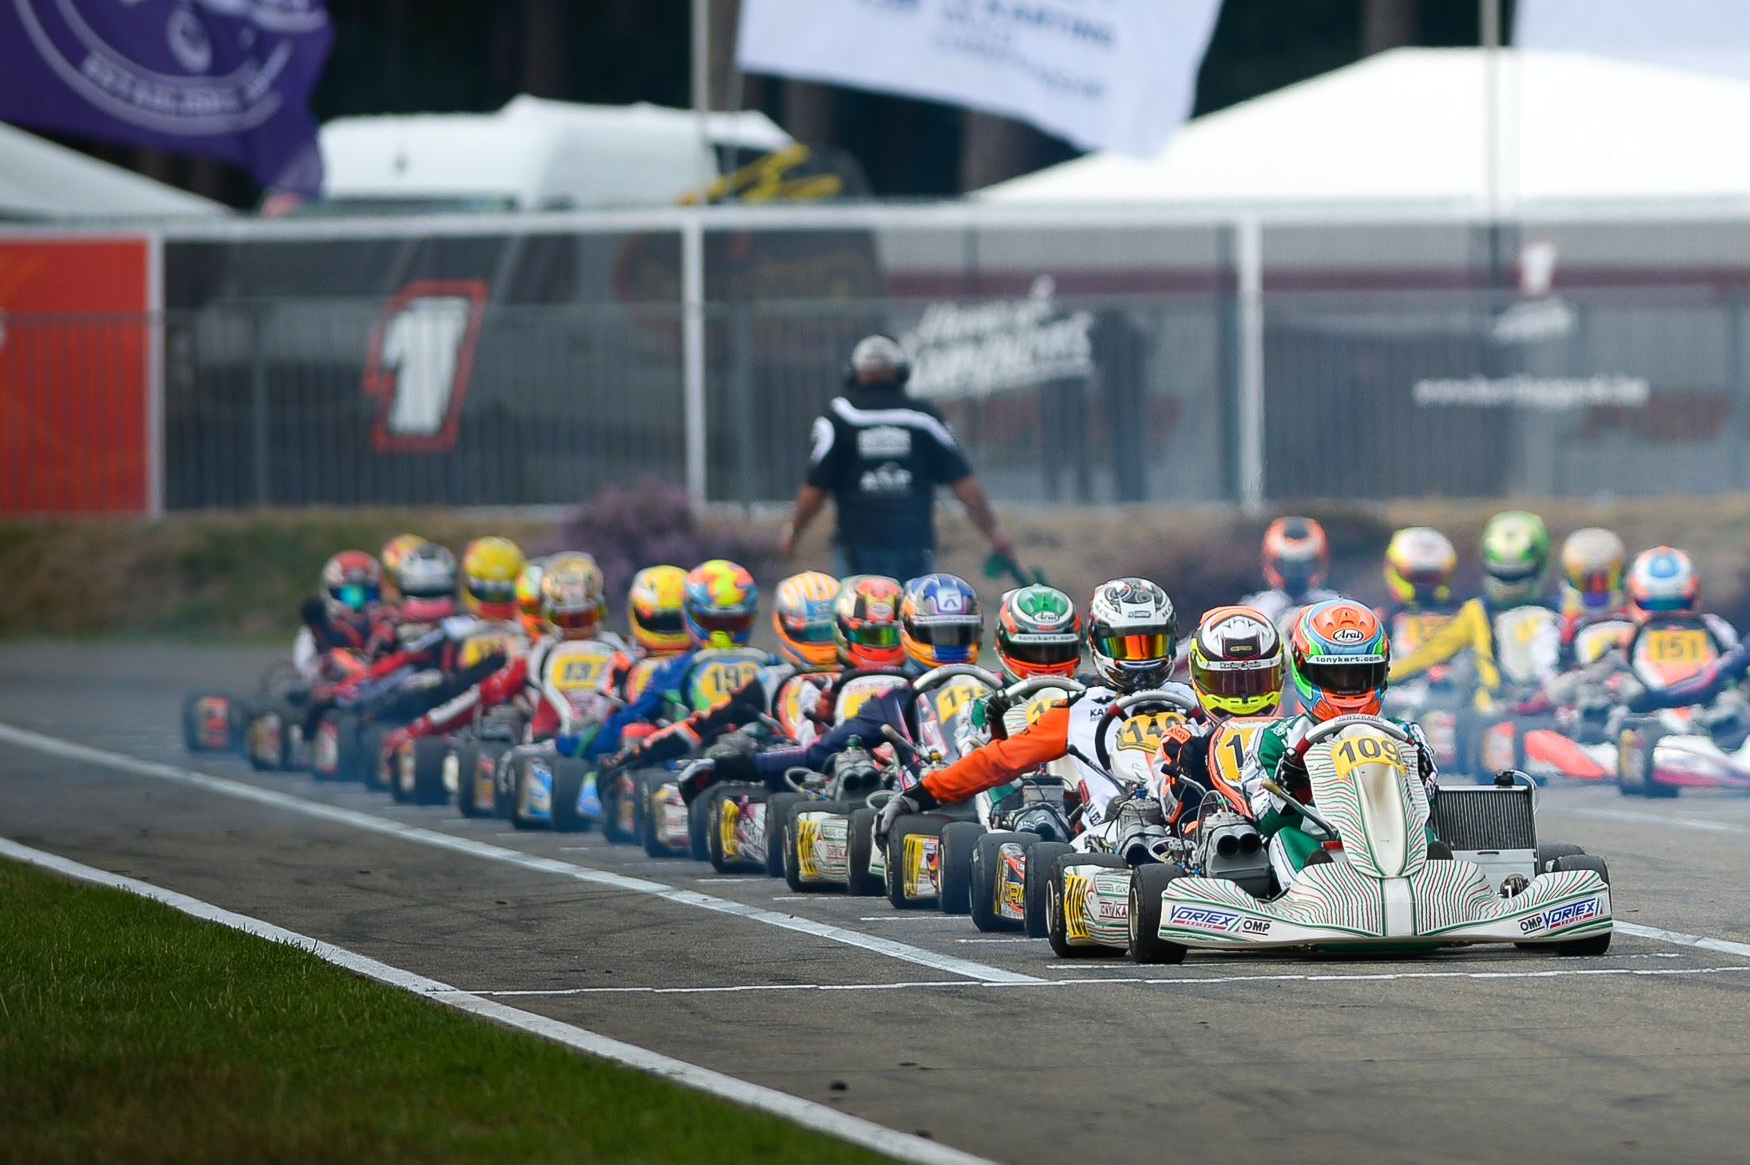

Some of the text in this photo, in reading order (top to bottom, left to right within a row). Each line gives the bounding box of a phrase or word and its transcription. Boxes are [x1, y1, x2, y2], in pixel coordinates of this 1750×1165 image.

[374, 288, 479, 444] 1
[1338, 629, 1361, 640] Arai
[1315, 656, 1381, 664] tonykart.com
[1338, 737, 1400, 765] 109
[1170, 905, 1271, 933] VORTEX OMP
[1519, 897, 1597, 932] OMP VORTEX
